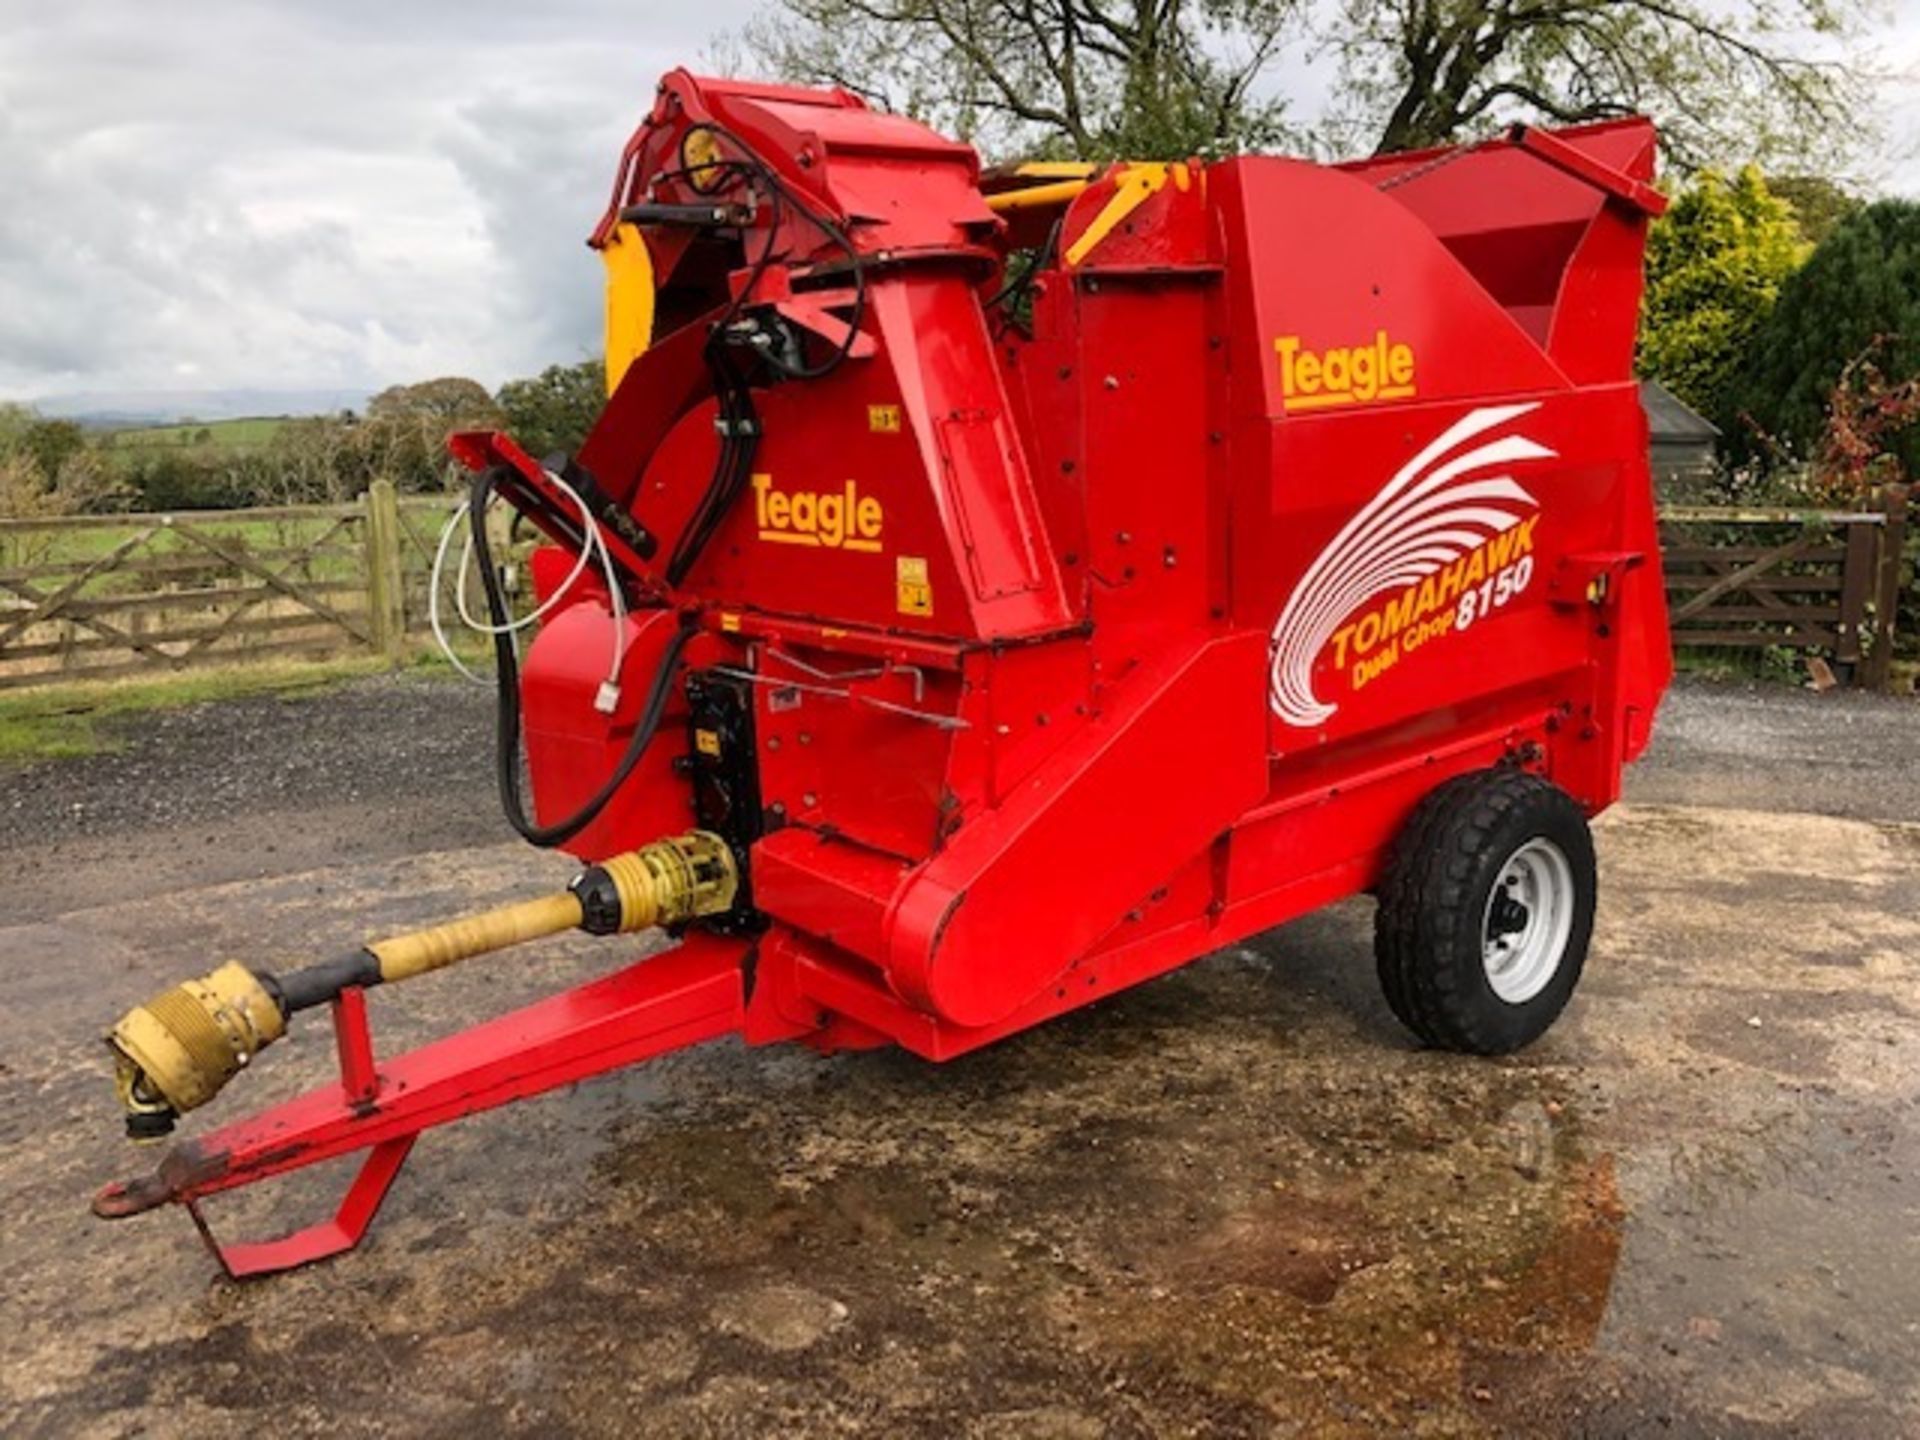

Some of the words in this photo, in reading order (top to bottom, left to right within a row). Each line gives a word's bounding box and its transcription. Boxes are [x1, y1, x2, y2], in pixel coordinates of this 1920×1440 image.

[1274, 330, 1415, 400] Teagle
[752, 473, 883, 547] Teagle
[1332, 514, 1540, 669] TOMAHAWK
[1352, 641, 1398, 690] Dual
[1403, 610, 1455, 652] Chop
[1456, 555, 1534, 630] 8150
